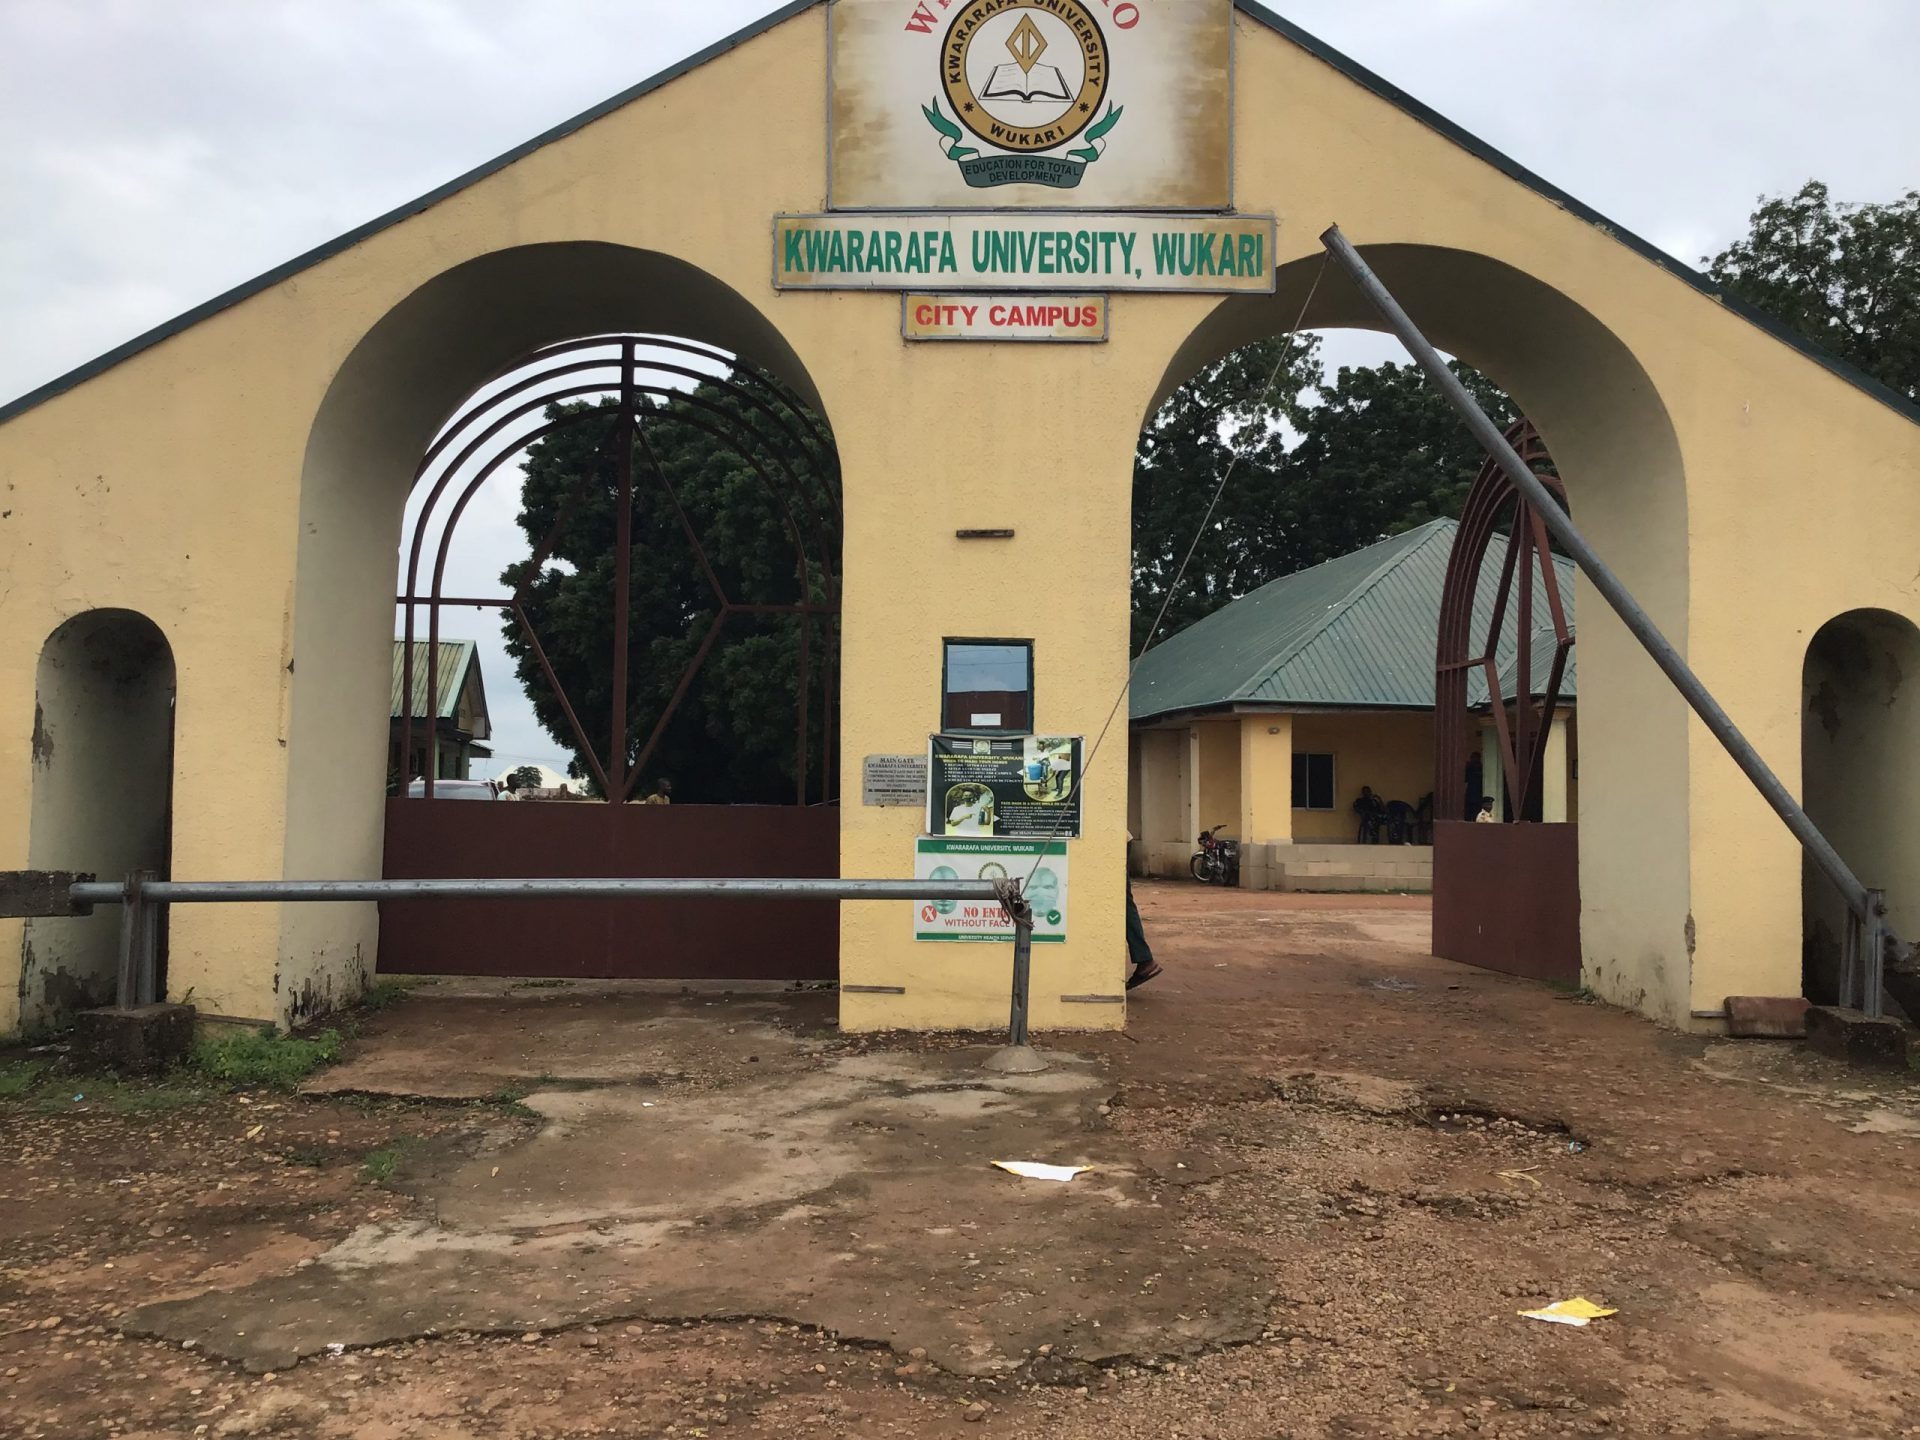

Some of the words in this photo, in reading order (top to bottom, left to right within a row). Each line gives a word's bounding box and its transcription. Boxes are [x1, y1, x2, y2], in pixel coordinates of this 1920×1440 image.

[990, 123, 1065, 145] WUKARI
[965, 160, 1022, 175] EDUCATION
[1024, 160, 1045, 170] FOR
[1047, 162, 1080, 176] TOTAL
[989, 171, 1063, 183] DEVELOPMENT
[785, 230, 957, 274] KWARARAFA
[972, 231, 1141, 279] UNIVERSITY,
[1153, 232, 1263, 277] WUKARI
[915, 305, 979, 326] CITY
[989, 305, 1098, 327] CAMPUS
[963, 907, 979, 918] NO
[944, 919, 986, 927] WITHOUT
[989, 919, 1010, 927] FACE
